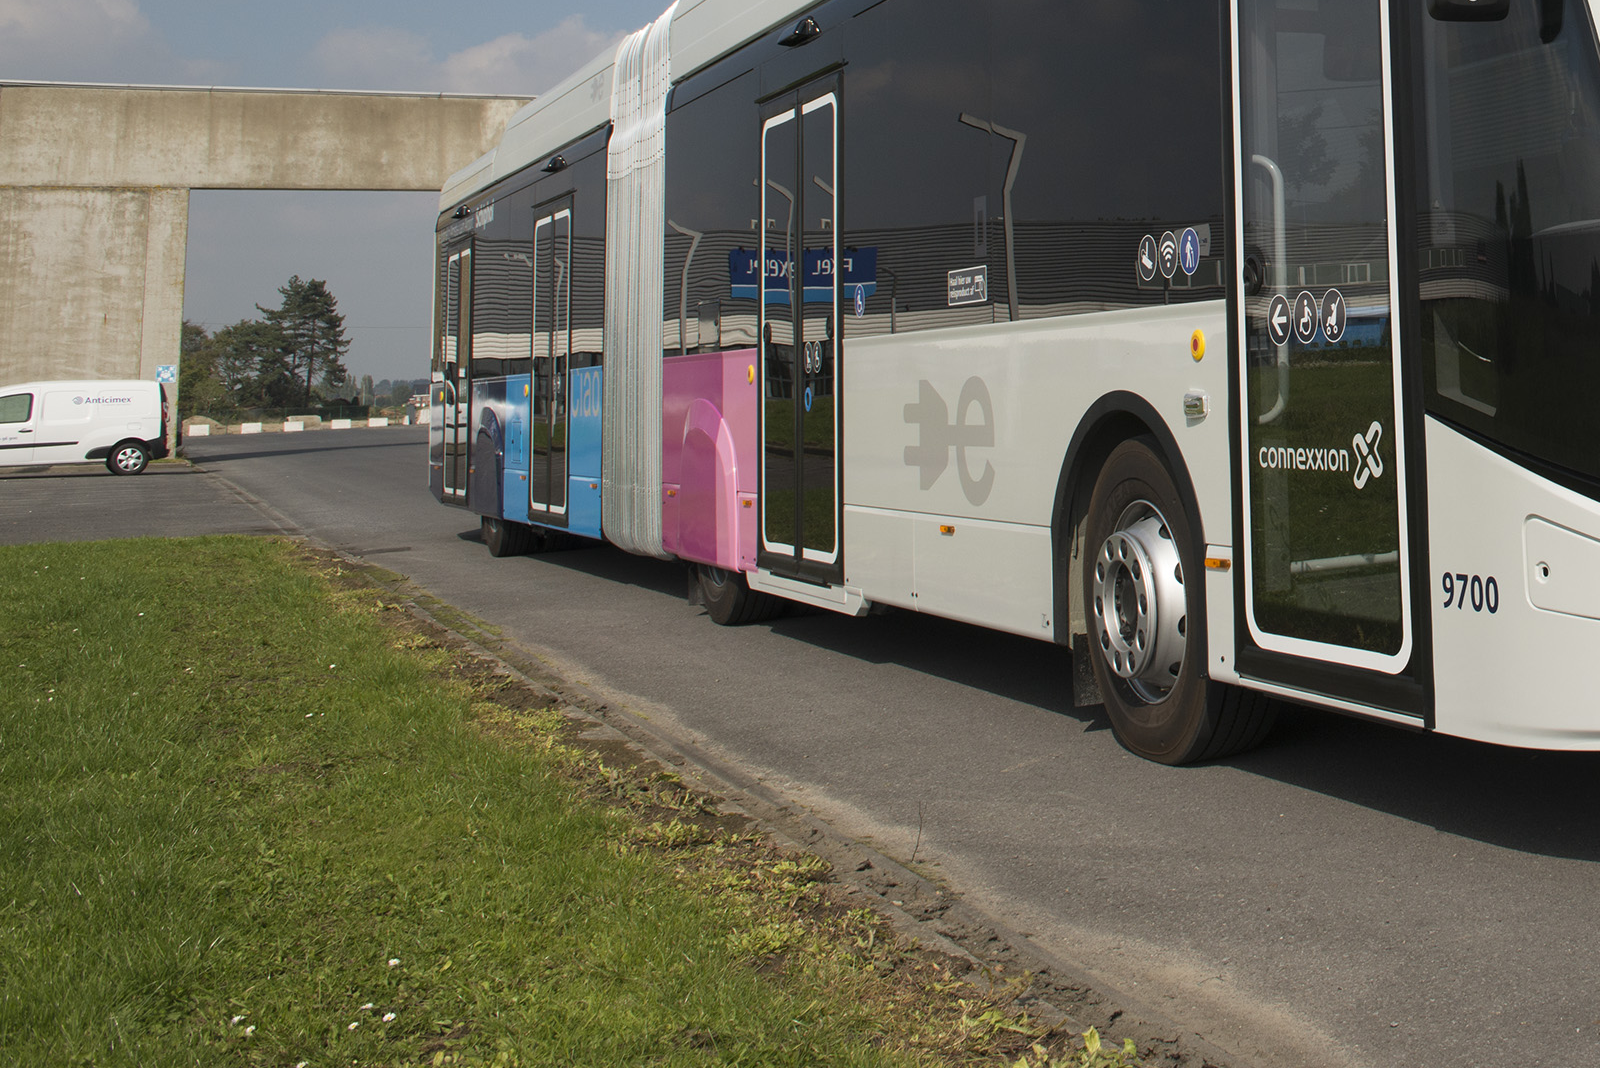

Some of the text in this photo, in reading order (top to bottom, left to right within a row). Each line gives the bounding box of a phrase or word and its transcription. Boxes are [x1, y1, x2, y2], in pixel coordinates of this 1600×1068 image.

[84, 396, 132, 405] Anticimex
[1259, 446, 1349, 472] connexxion
[1442, 572, 1499, 614] 9700
